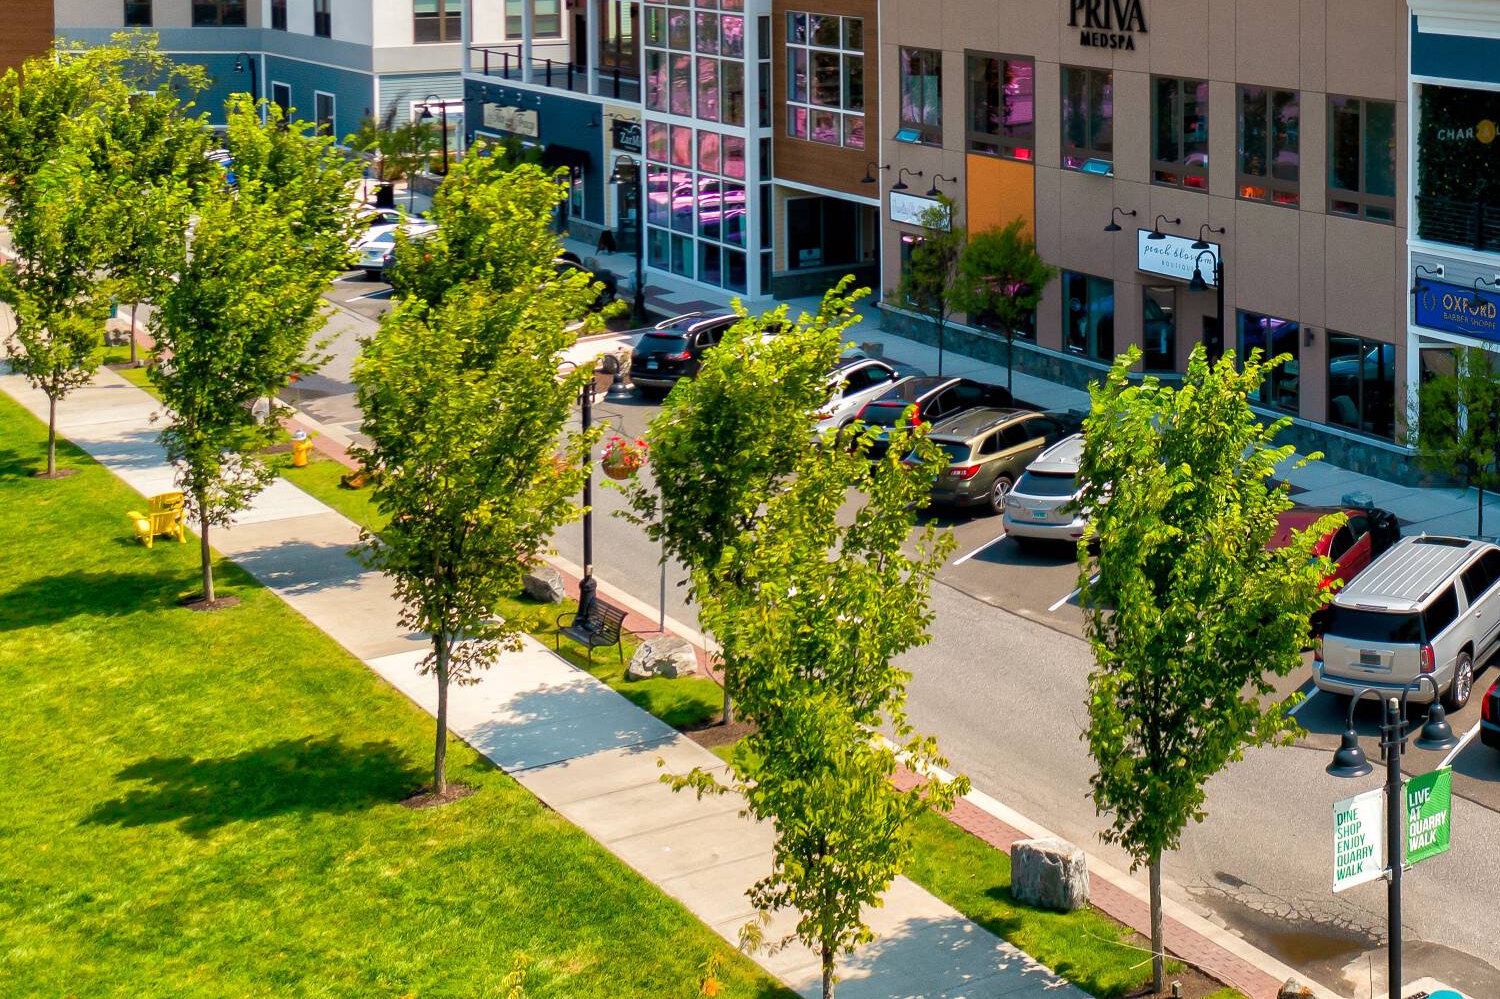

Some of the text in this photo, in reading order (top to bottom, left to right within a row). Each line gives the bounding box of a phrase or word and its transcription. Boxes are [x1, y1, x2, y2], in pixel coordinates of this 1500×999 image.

[1080, 31, 1135, 51] MEDSPA
[1437, 127, 1474, 141] CHAR
[1144, 244, 1172, 256] peach
[1409, 787, 1430, 808] LIVE
[1337, 808, 1358, 826] DINE
[1409, 805, 1423, 823] AT
[1409, 809, 1447, 837] QUARRY
[1337, 821, 1361, 840] SHOP
[1337, 833, 1365, 854] ENJOY
[1409, 830, 1436, 852] WALK
[1337, 845, 1374, 868] QUARRY
[1336, 862, 1363, 881] WALK
